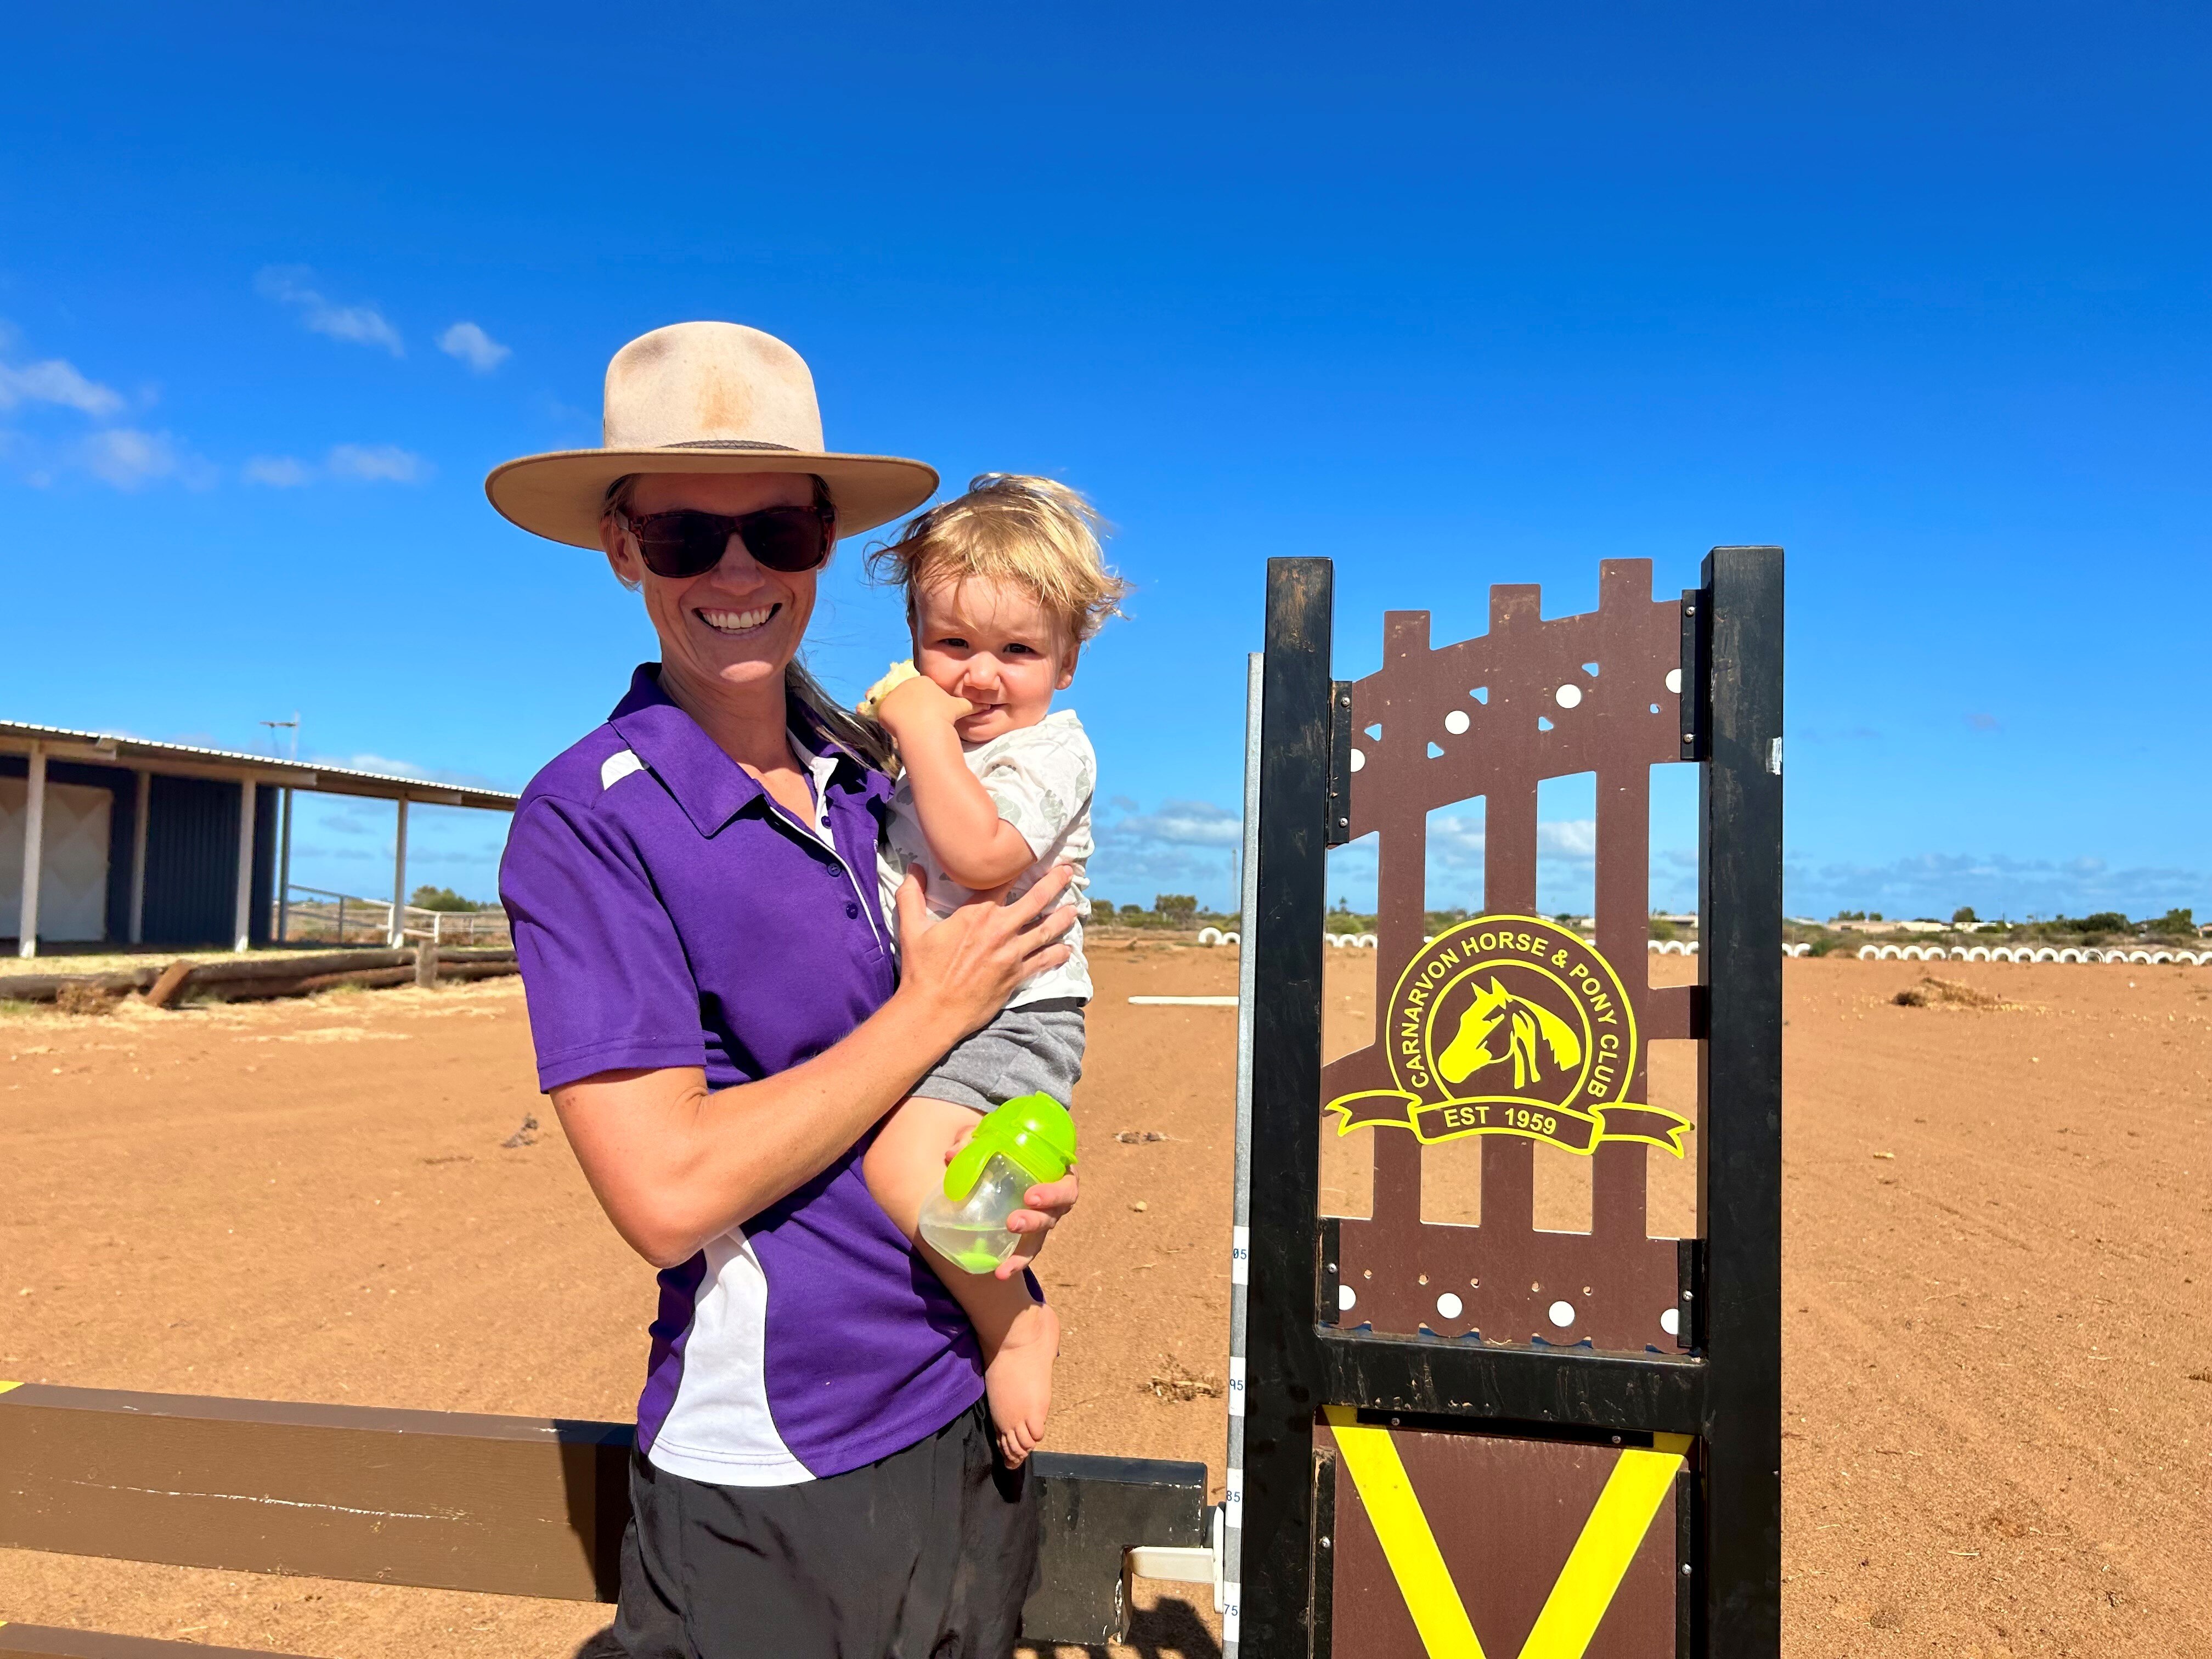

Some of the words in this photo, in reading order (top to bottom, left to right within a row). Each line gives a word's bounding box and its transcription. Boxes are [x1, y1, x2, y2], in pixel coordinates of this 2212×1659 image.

[1461, 932, 1549, 957] HORSE
[1551, 950, 1567, 968] &
[1569, 963, 1619, 1025] PONY
[1401, 948, 1460, 1089] CARNARVON
[1587, 1034, 1620, 1097] CLUB
[1444, 1106, 1489, 1128] EST
[1504, 1108, 1557, 1135] 1959
[1229, 1378, 1244, 1391] 95
[1226, 1490, 1240, 1503] 85
[1223, 1603, 1238, 1616] 75
